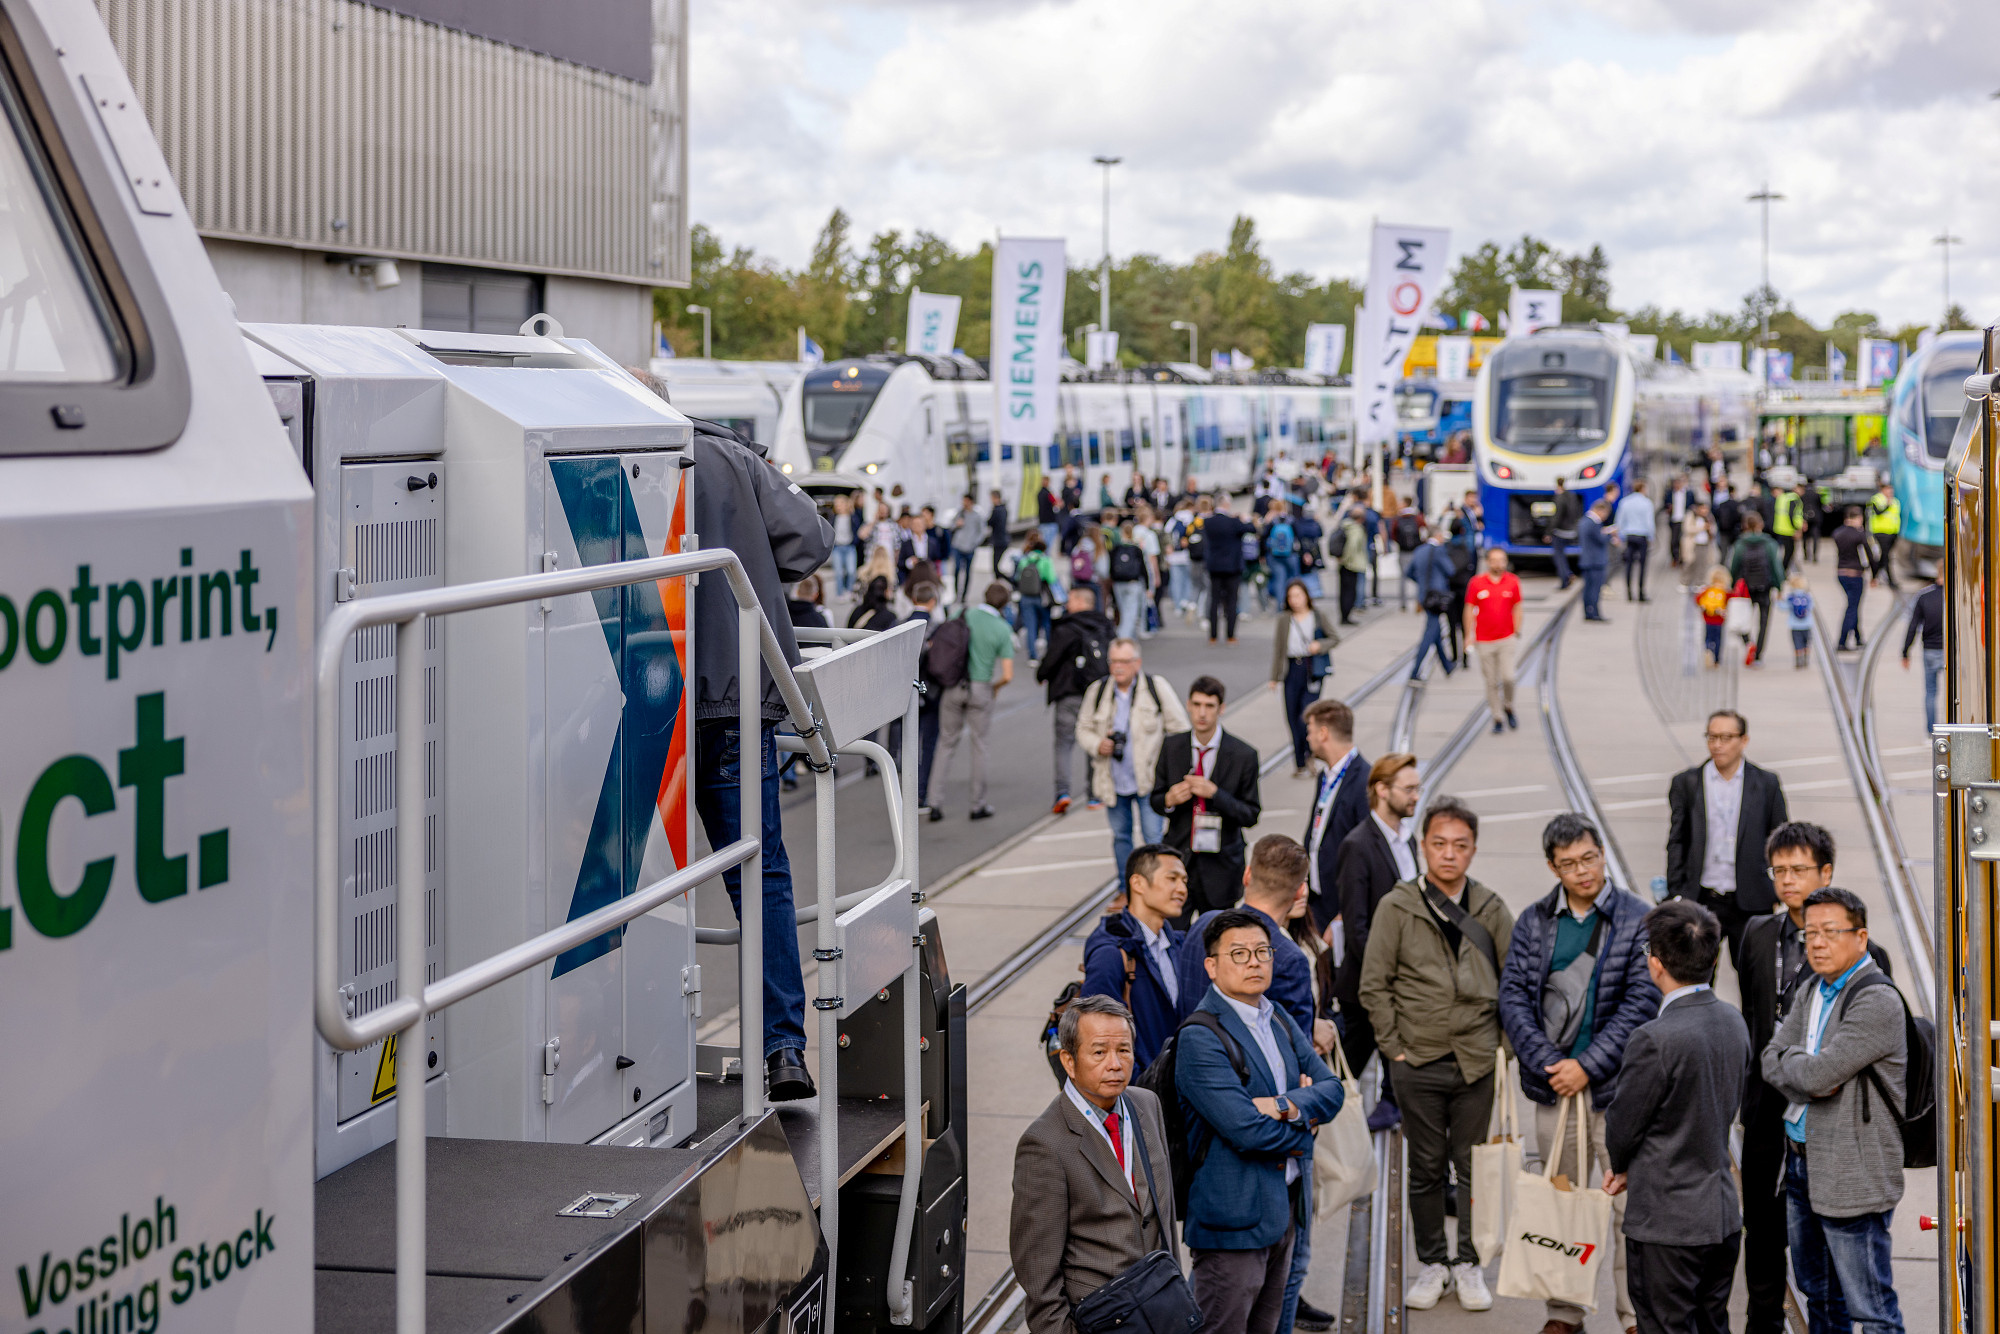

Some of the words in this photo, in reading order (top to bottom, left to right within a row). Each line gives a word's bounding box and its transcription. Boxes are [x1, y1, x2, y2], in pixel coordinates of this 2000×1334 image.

[1010, 260, 1044, 421] SIEMENS
[0, 690, 229, 952] ct.
[17, 1195, 177, 1320] Vossloh
[170, 1207, 276, 1305] Stock
